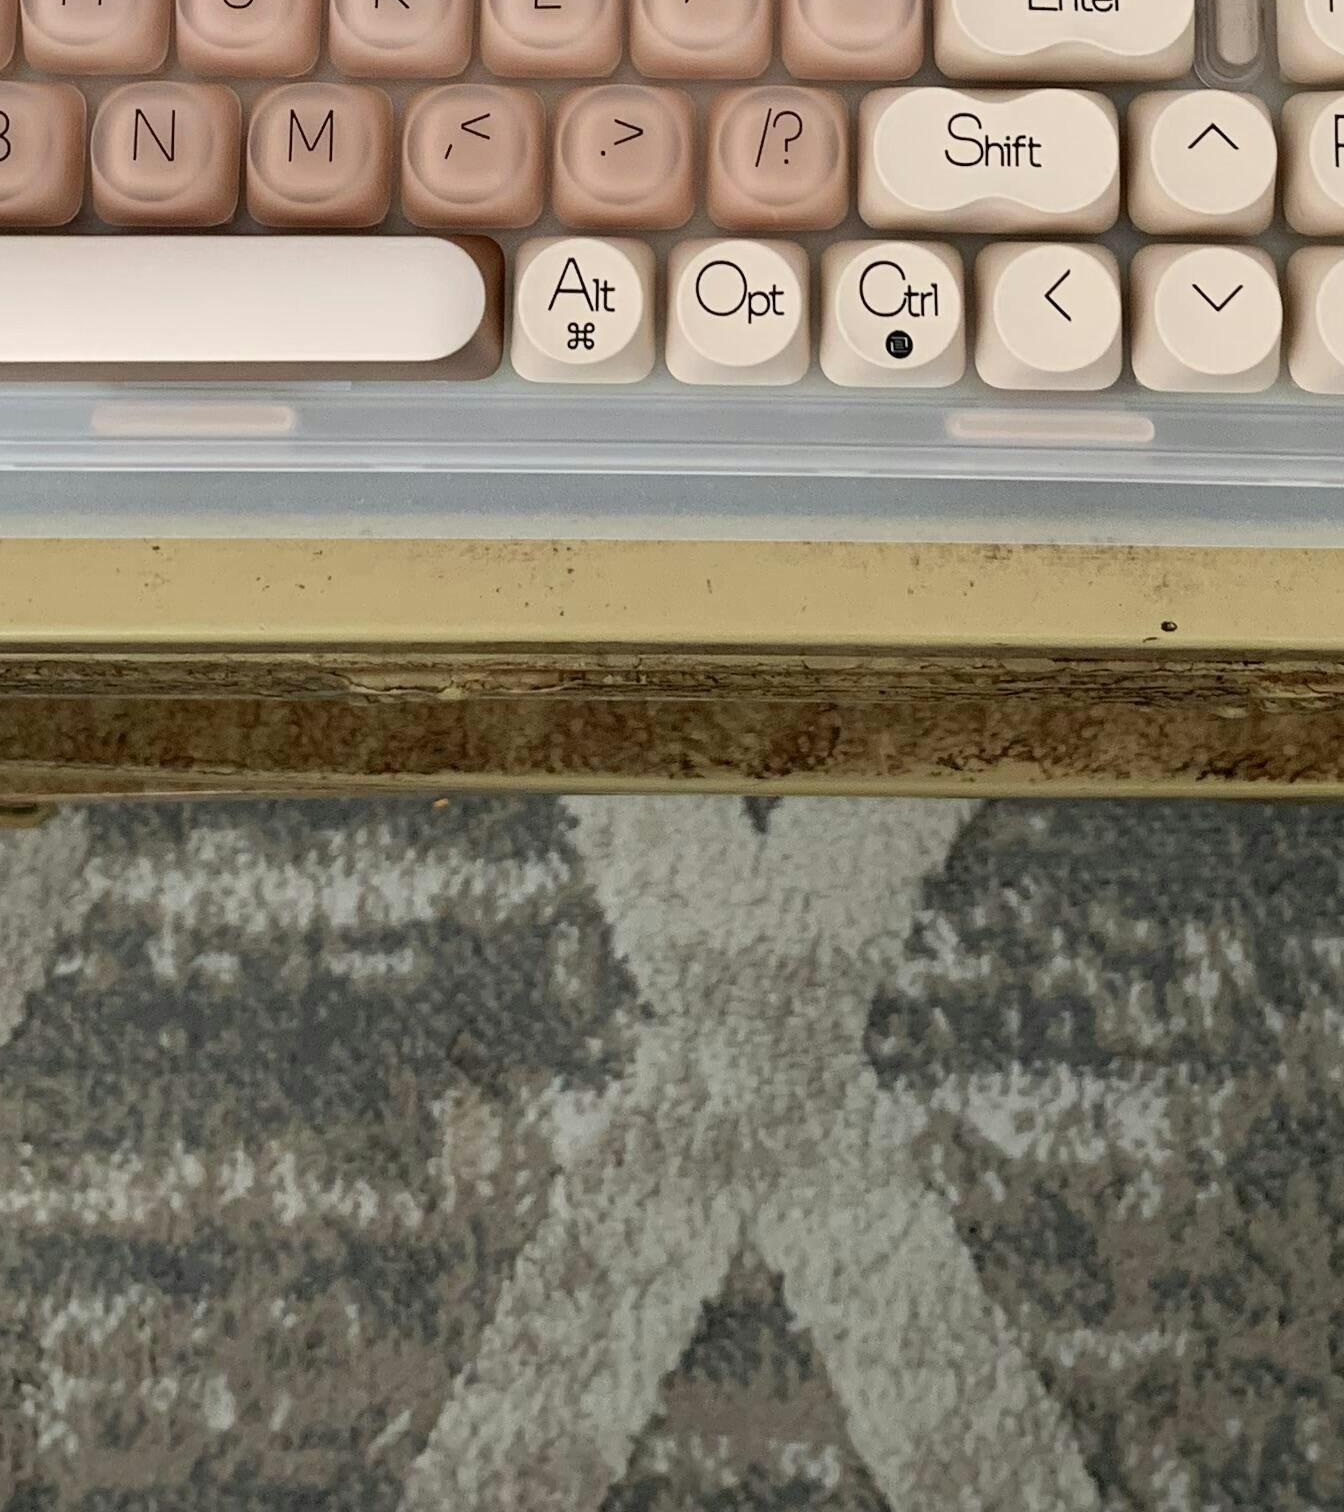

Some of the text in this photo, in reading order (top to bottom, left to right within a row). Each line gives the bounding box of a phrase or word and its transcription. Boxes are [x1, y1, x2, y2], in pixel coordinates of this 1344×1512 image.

[132, 108, 176, 162] N
[288, 108, 334, 163] M
[944, 112, 1042, 168] Shift
[547, 257, 616, 313] Alt
[695, 260, 785, 325] Opt
[858, 260, 939, 318] Ctrl
